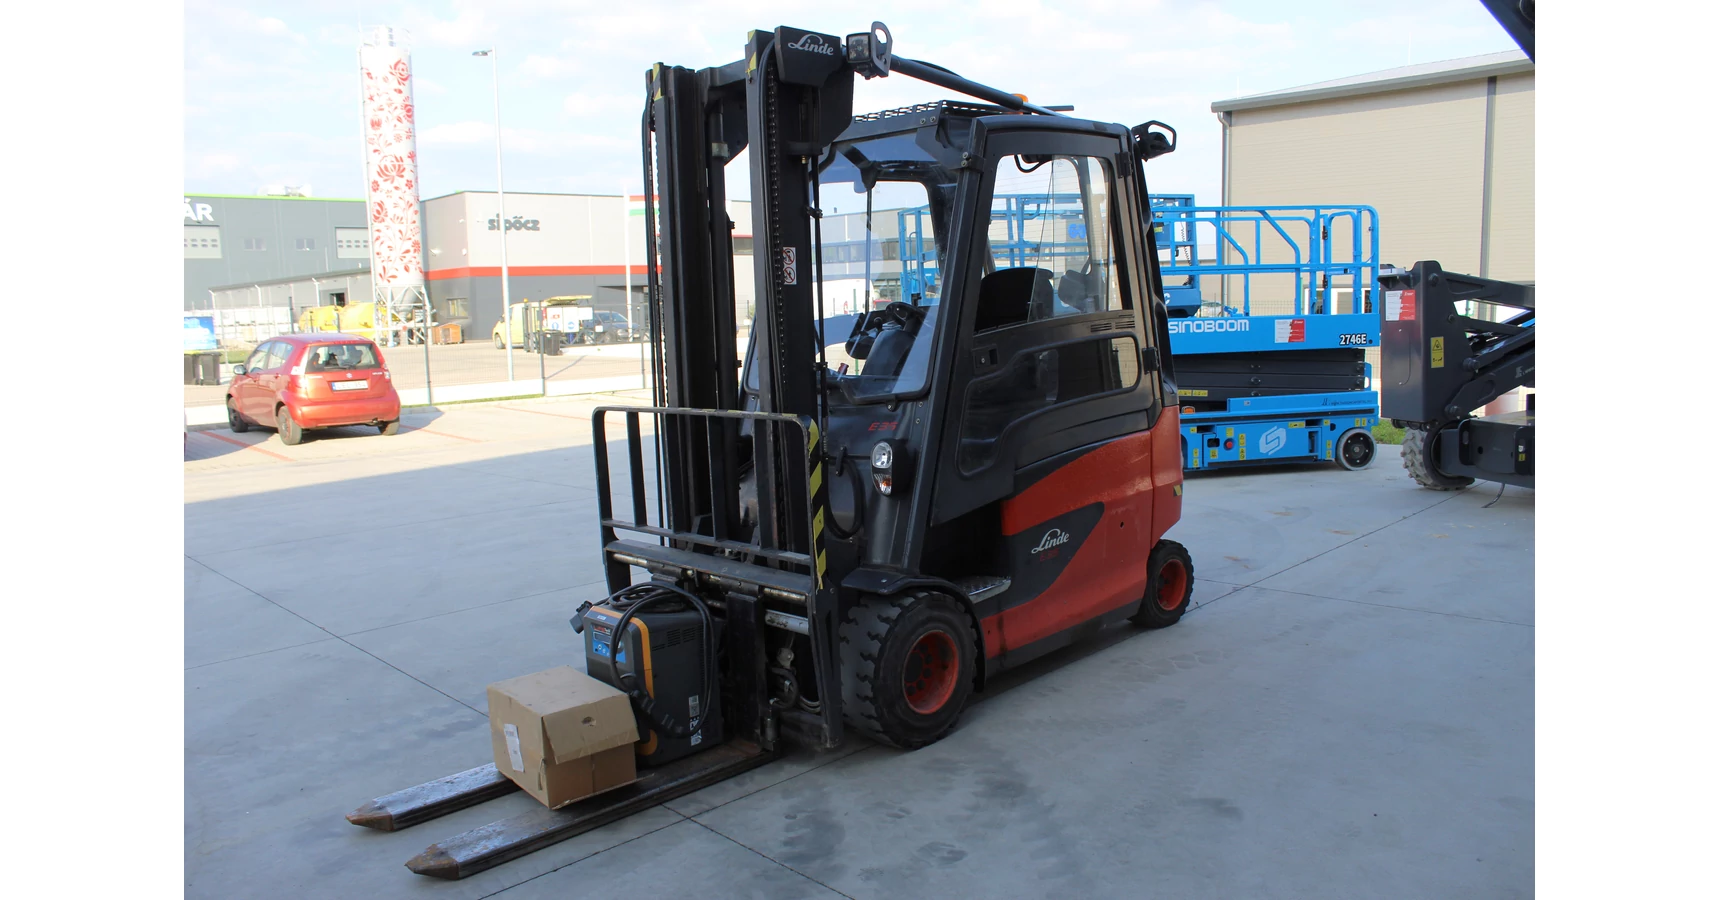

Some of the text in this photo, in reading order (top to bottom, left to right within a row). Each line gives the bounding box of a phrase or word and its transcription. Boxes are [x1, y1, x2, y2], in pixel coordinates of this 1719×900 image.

[788, 33, 834, 56] Linde
[488, 213, 540, 235] sipőcz
[1168, 319, 1250, 334] SINOBOOM
[1339, 333, 1367, 346] 2746E
[868, 421, 899, 431] E35
[1031, 528, 1070, 554] Linde
